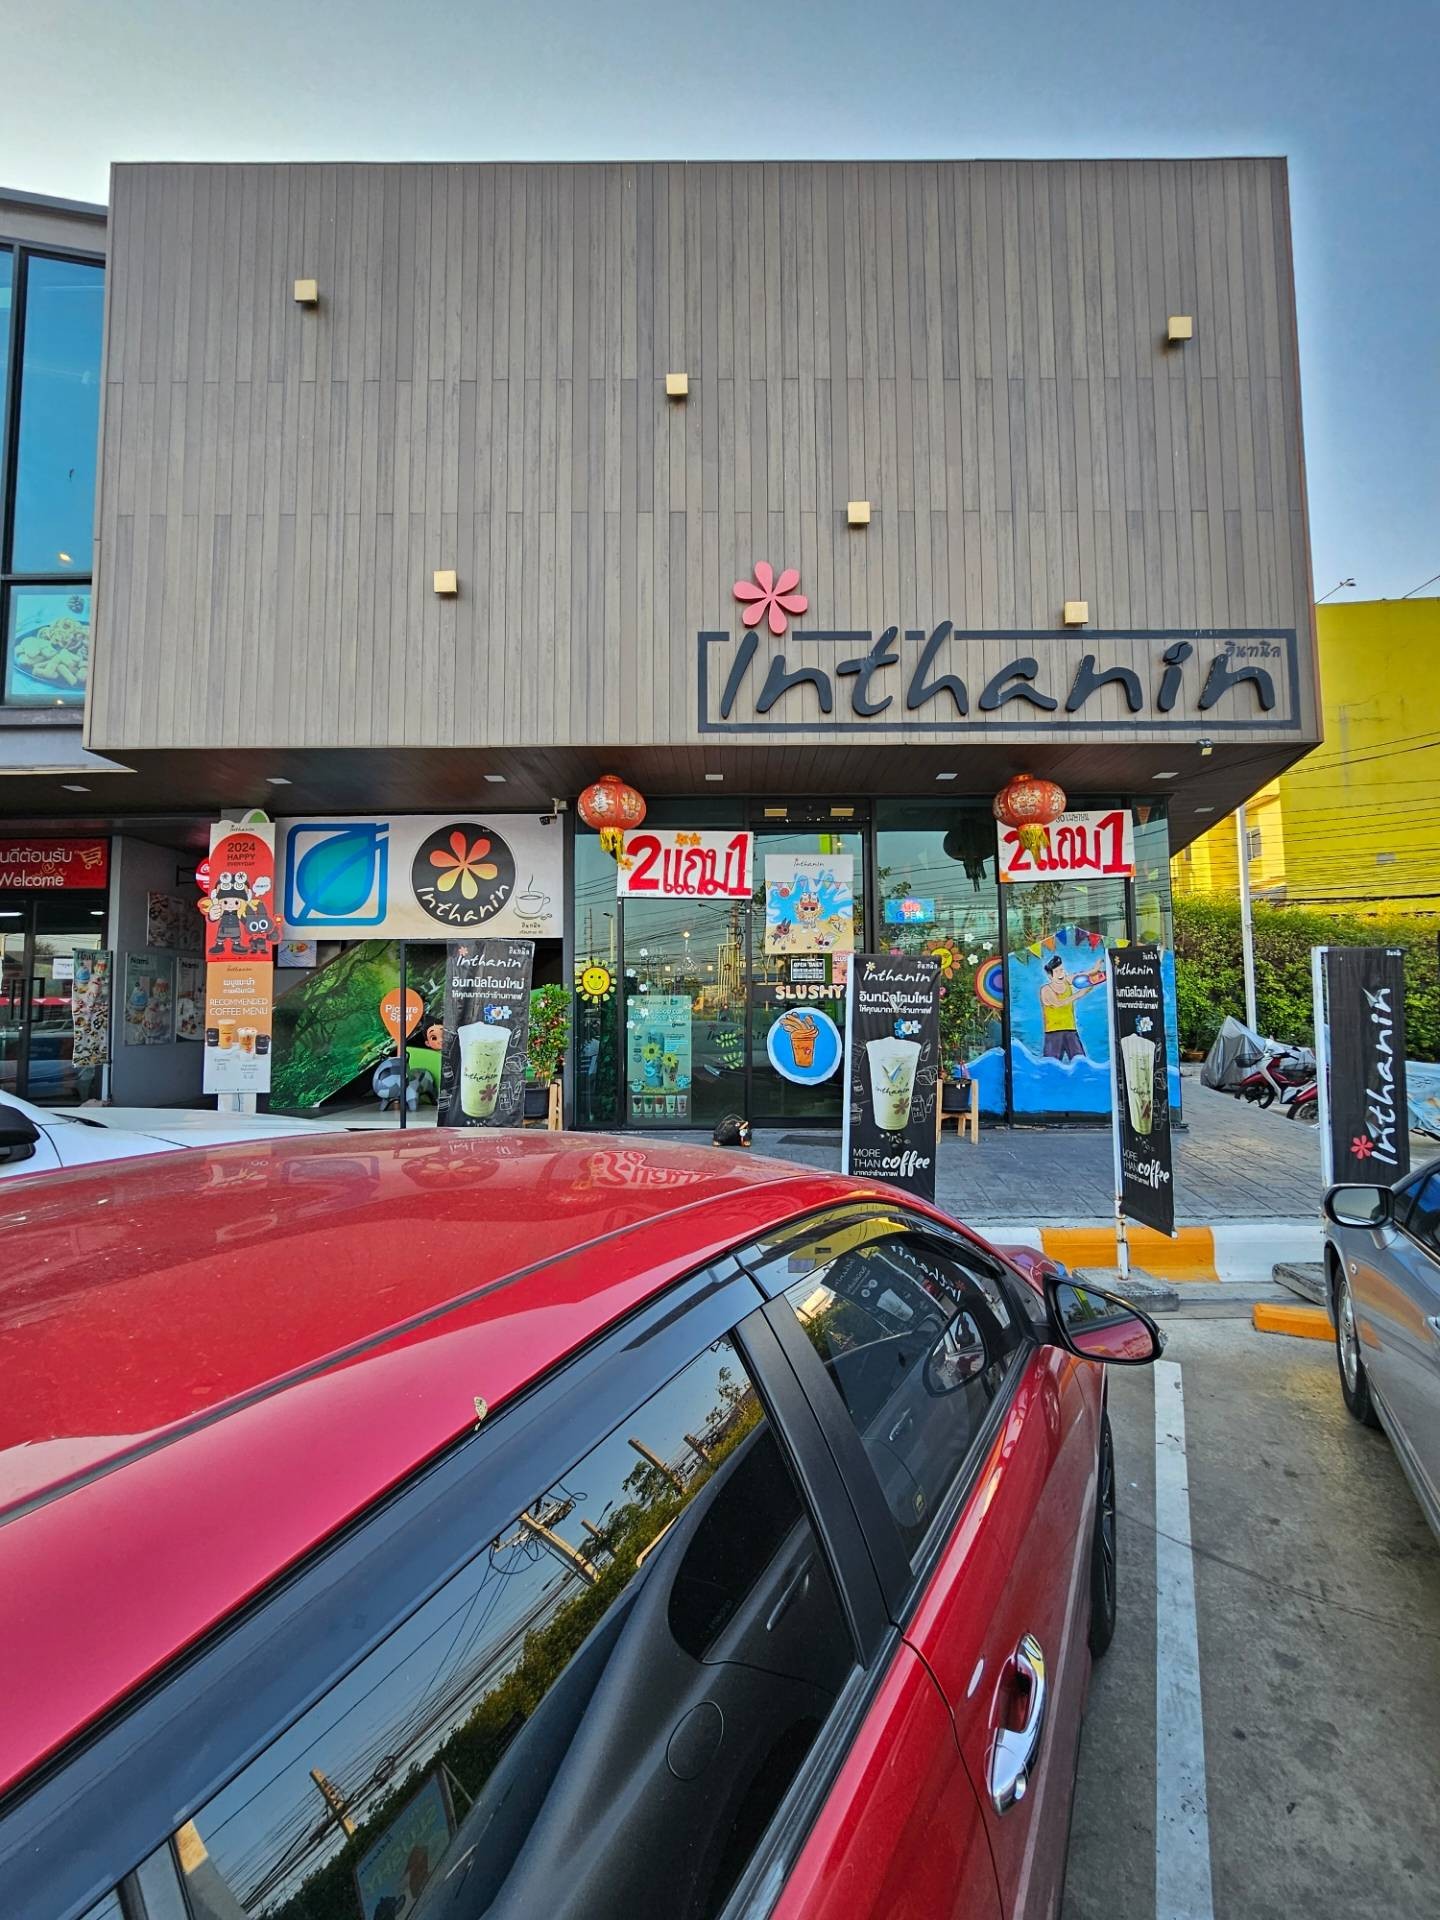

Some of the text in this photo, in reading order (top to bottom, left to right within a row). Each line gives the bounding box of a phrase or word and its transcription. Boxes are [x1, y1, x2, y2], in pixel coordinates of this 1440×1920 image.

[720, 621, 1276, 719] Inthanin
[227, 842, 256, 852] 2024
[227, 853, 256, 861] HAPPY
[0, 870, 65, 887] Welcome
[417, 884, 510, 922] Inthanin
[456, 954, 522, 968] Inthanin
[863, 969, 932, 982] Inthanin
[452, 976, 525, 990] อินทนิลโฉมใหม่
[775, 984, 844, 1000] SLUSHY
[209, 1007, 268, 1015] COFFEE MENU
[385, 1004, 418, 1014] Picure
[390, 1013, 412, 1023] Spt
[1366, 988, 1398, 1165] Inthanin
[853, 1148, 881, 1157] MORE
[854, 1150, 930, 1177] THAN coffee
[1138, 1160, 1169, 1189] coffee
